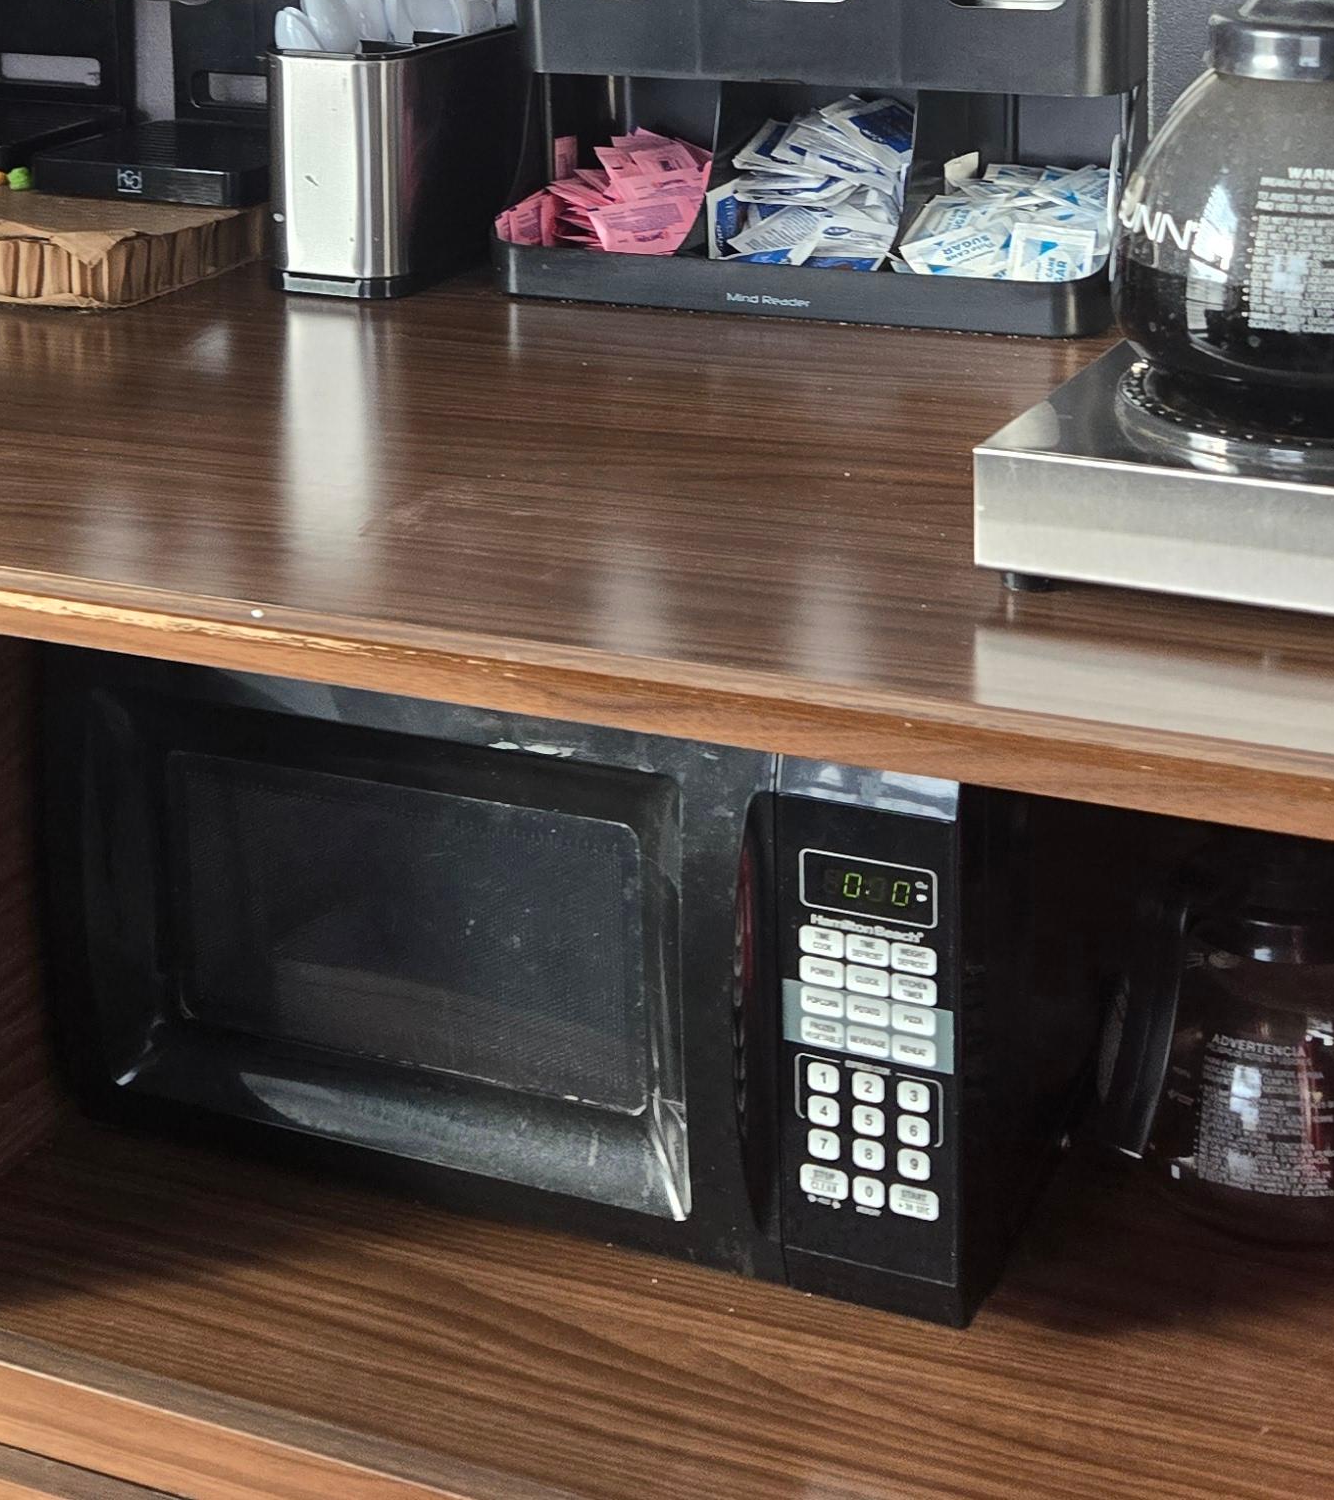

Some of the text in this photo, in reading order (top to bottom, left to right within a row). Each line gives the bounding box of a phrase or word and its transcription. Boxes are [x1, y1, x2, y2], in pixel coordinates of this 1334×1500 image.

[942, 234, 991, 255] SUGAR
[810, 913, 922, 943] Hamilton Beach
[1212, 1034, 1306, 1058] ADVERTENCIA
[819, 1071, 827, 1084] 1
[864, 1081, 873, 1094] 2
[908, 1090, 919, 1102] 3
[819, 1105, 828, 1117] 4
[864, 1114, 873, 1127] 5
[908, 1124, 918, 1137] 6
[819, 1137, 829, 1150] 7
[864, 1147, 873, 1161] 8
[909, 1158, 919, 1171] 9
[864, 1185, 873, 1198] 0
